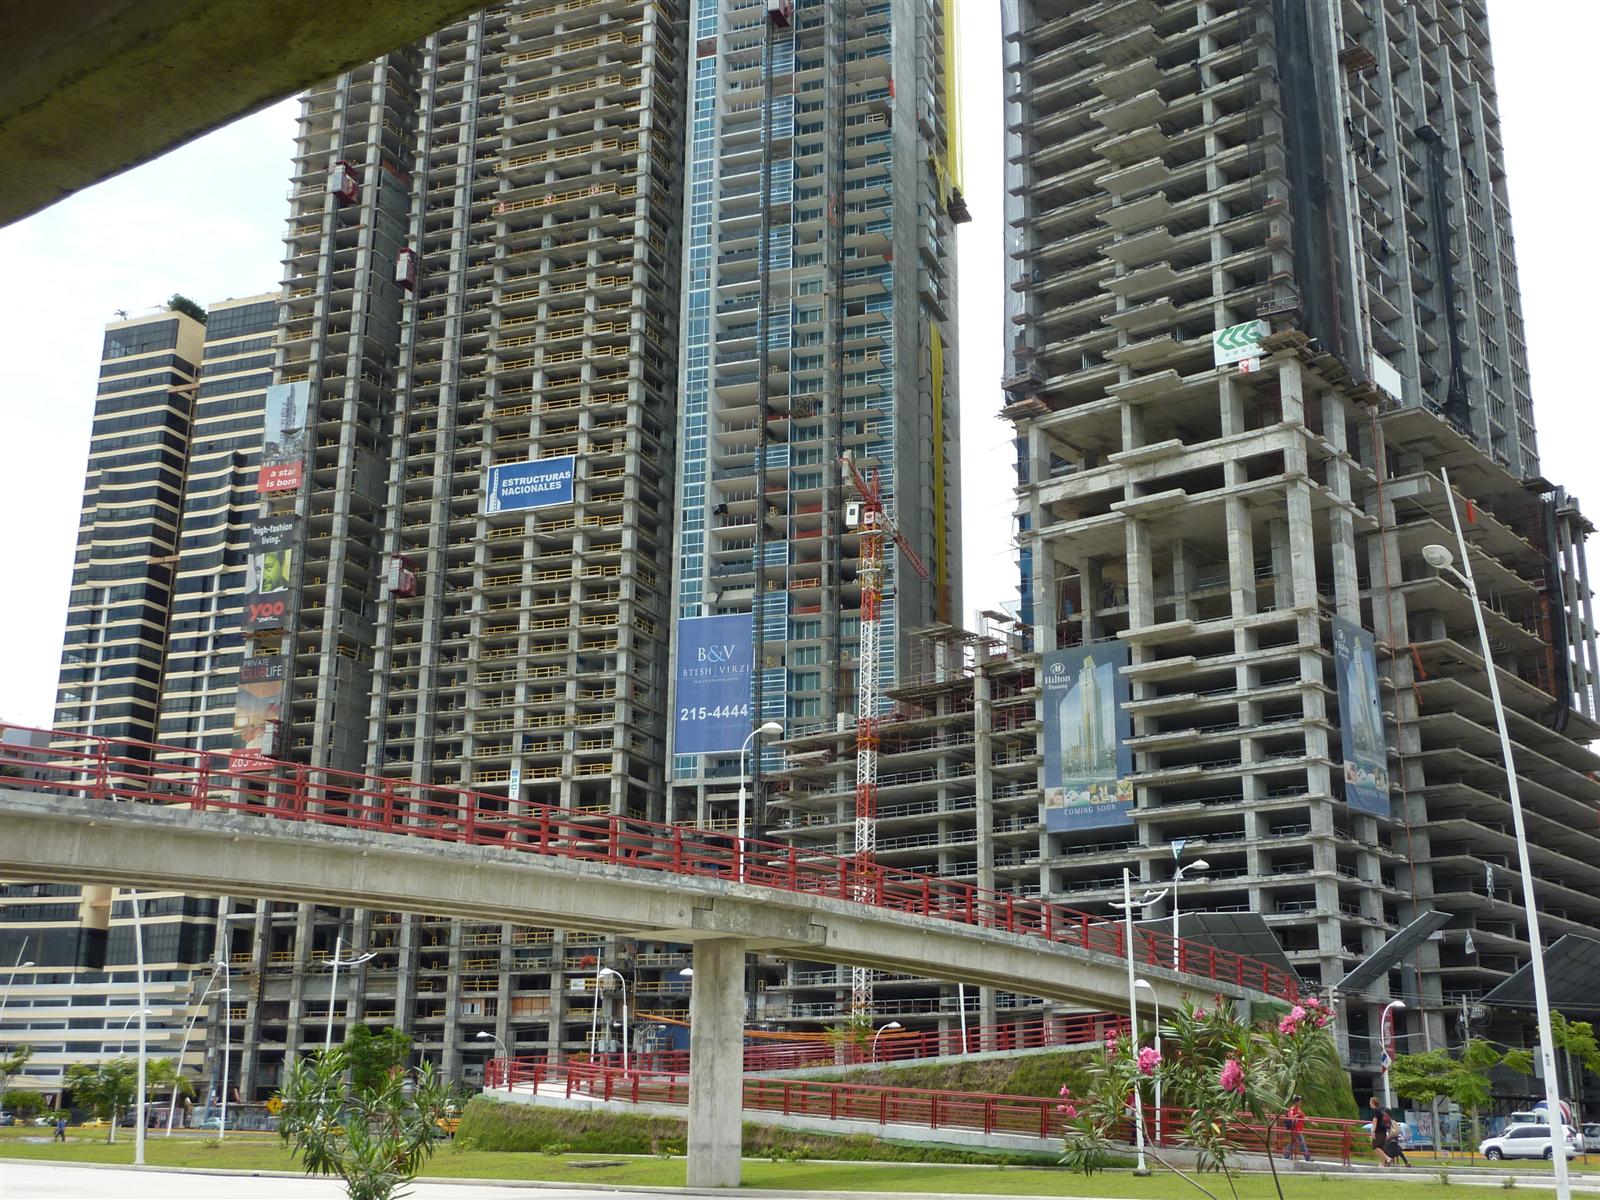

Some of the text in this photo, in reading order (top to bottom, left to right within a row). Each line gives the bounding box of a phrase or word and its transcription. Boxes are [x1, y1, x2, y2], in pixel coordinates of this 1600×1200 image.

[266, 479, 297, 488] is born
[502, 470, 572, 488] ESTRUCTURAS
[501, 481, 562, 497] NACIONALES
[249, 601, 284, 622] yoo
[697, 644, 736, 663] B&V
[243, 658, 271, 667] PRIVATE
[1044, 675, 1071, 685] Hilton
[680, 703, 749, 721] 215-4444
[1063, 803, 1117, 816] COMING SOON
